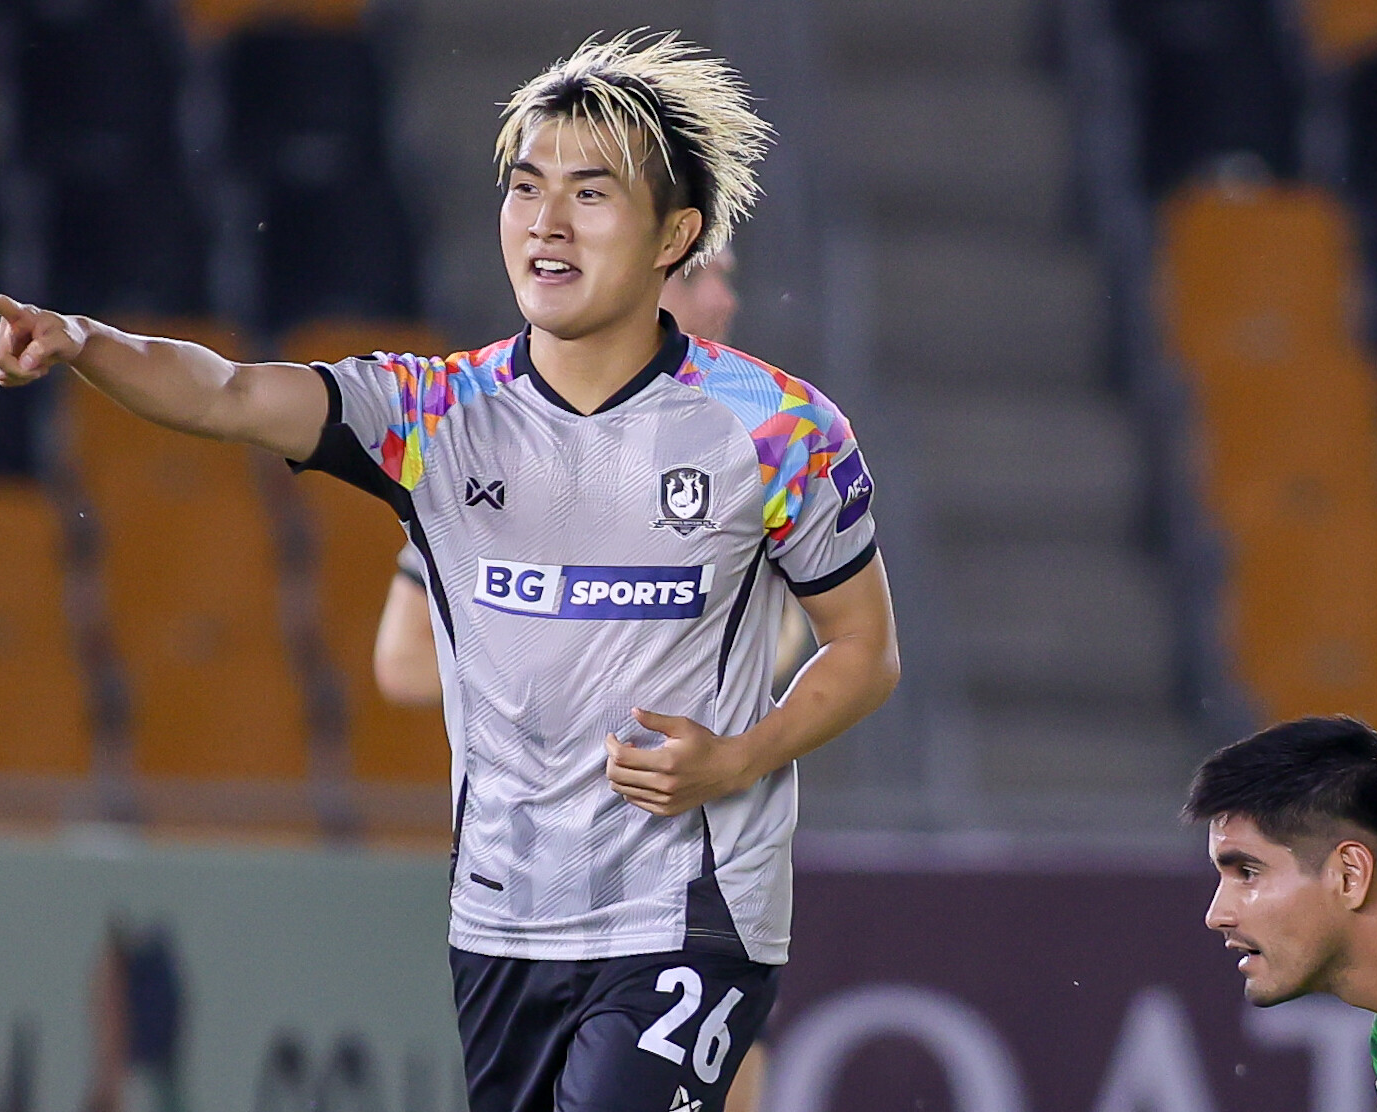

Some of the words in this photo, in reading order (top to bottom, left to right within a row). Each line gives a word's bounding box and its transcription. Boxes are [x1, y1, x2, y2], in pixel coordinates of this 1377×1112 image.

[486, 565, 545, 603] BG
[570, 580, 695, 606] SPORTS
[637, 966, 744, 1083] 26
